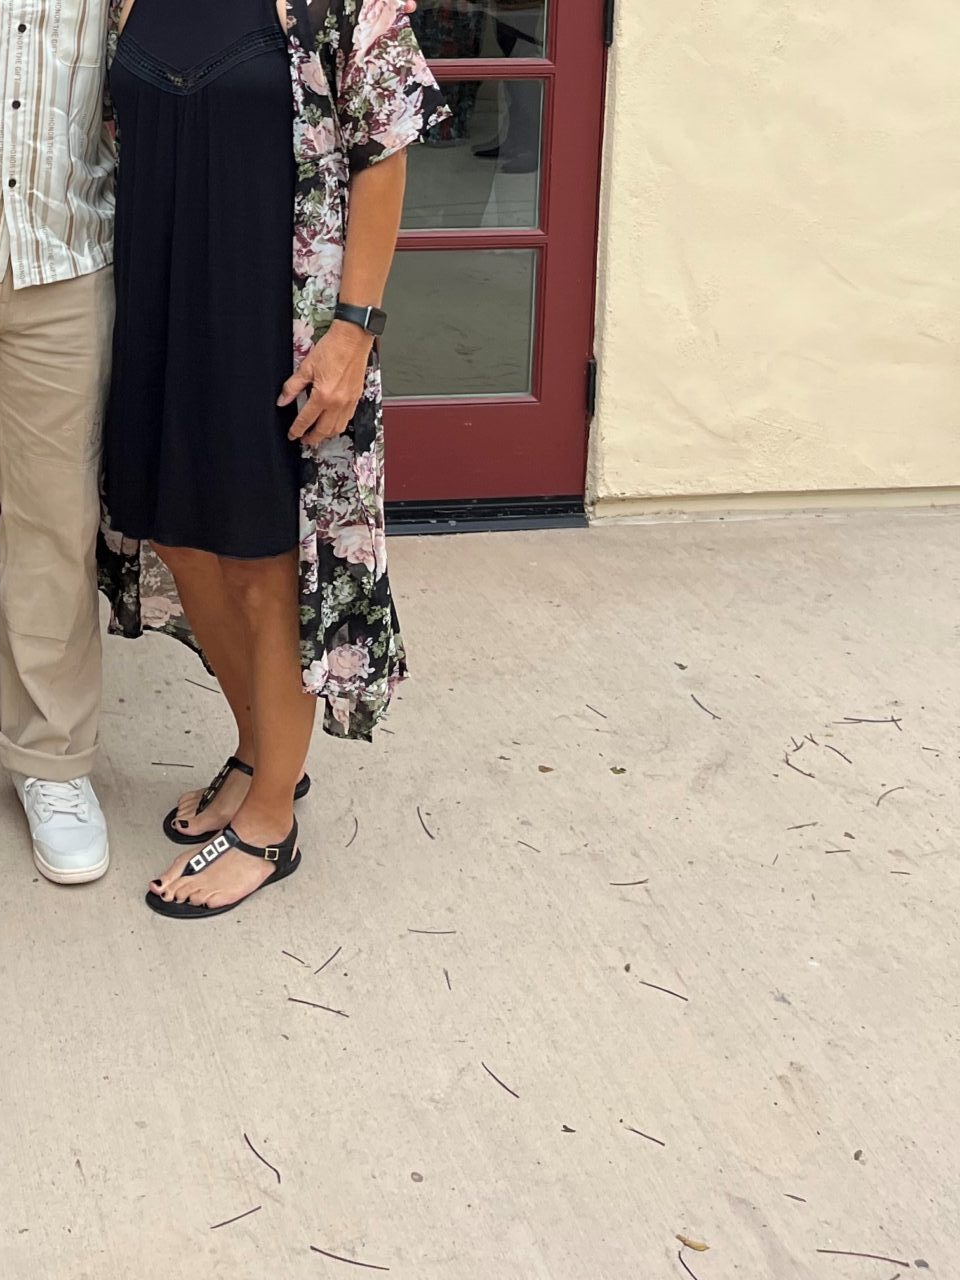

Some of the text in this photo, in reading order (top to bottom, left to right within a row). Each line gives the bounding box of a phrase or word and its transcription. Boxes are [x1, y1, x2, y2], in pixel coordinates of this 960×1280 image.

[54, 0, 62, 23] HONOR
[52, 25, 60, 38] THE
[46, 117, 55, 170] HONOR THE GIFT
